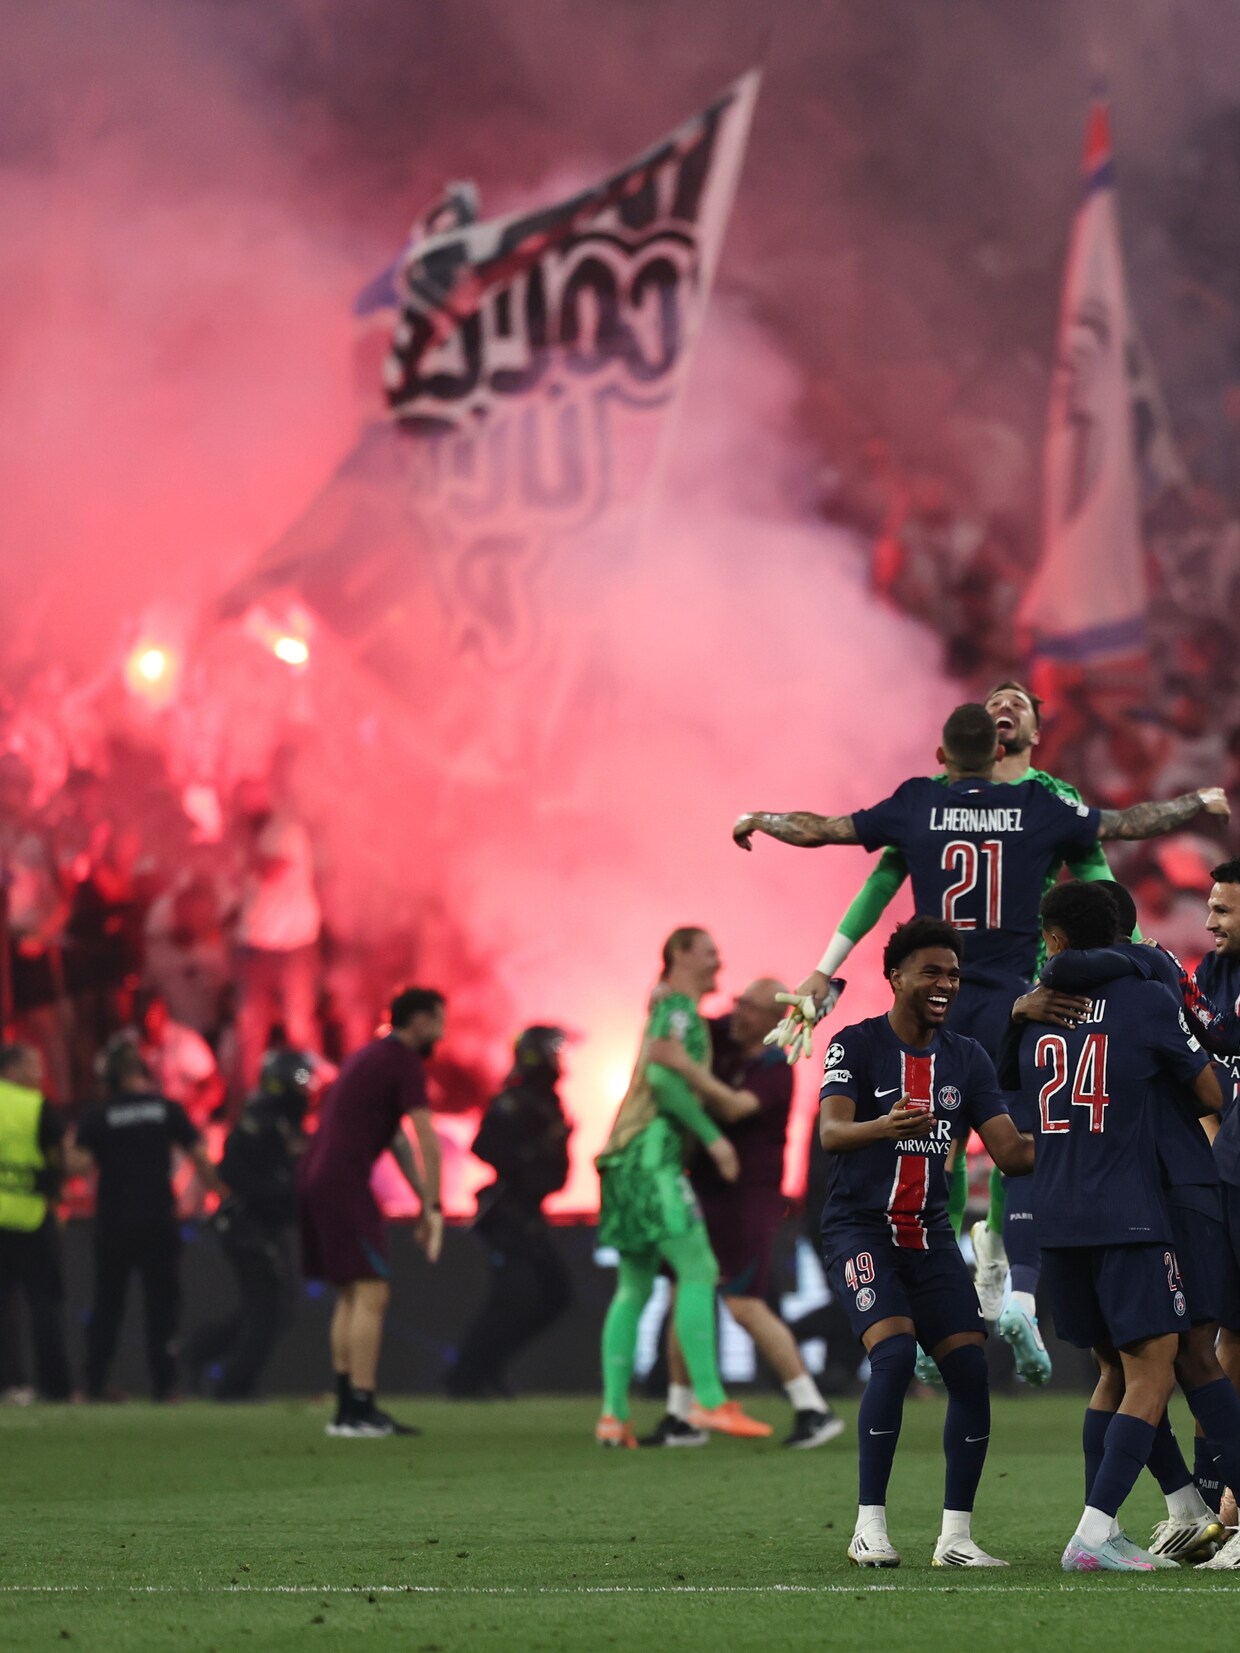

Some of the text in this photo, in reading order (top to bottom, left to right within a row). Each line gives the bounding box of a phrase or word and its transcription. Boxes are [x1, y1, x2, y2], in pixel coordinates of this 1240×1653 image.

[929, 807, 1024, 832] L.HERNANDEZ
[941, 839, 1003, 930] 21
[1034, 1033, 1110, 1134] 24
[894, 1139, 951, 1155] AIRWAYS
[845, 1252, 876, 1291] 49
[1198, 1477, 1219, 1490] PARIS
